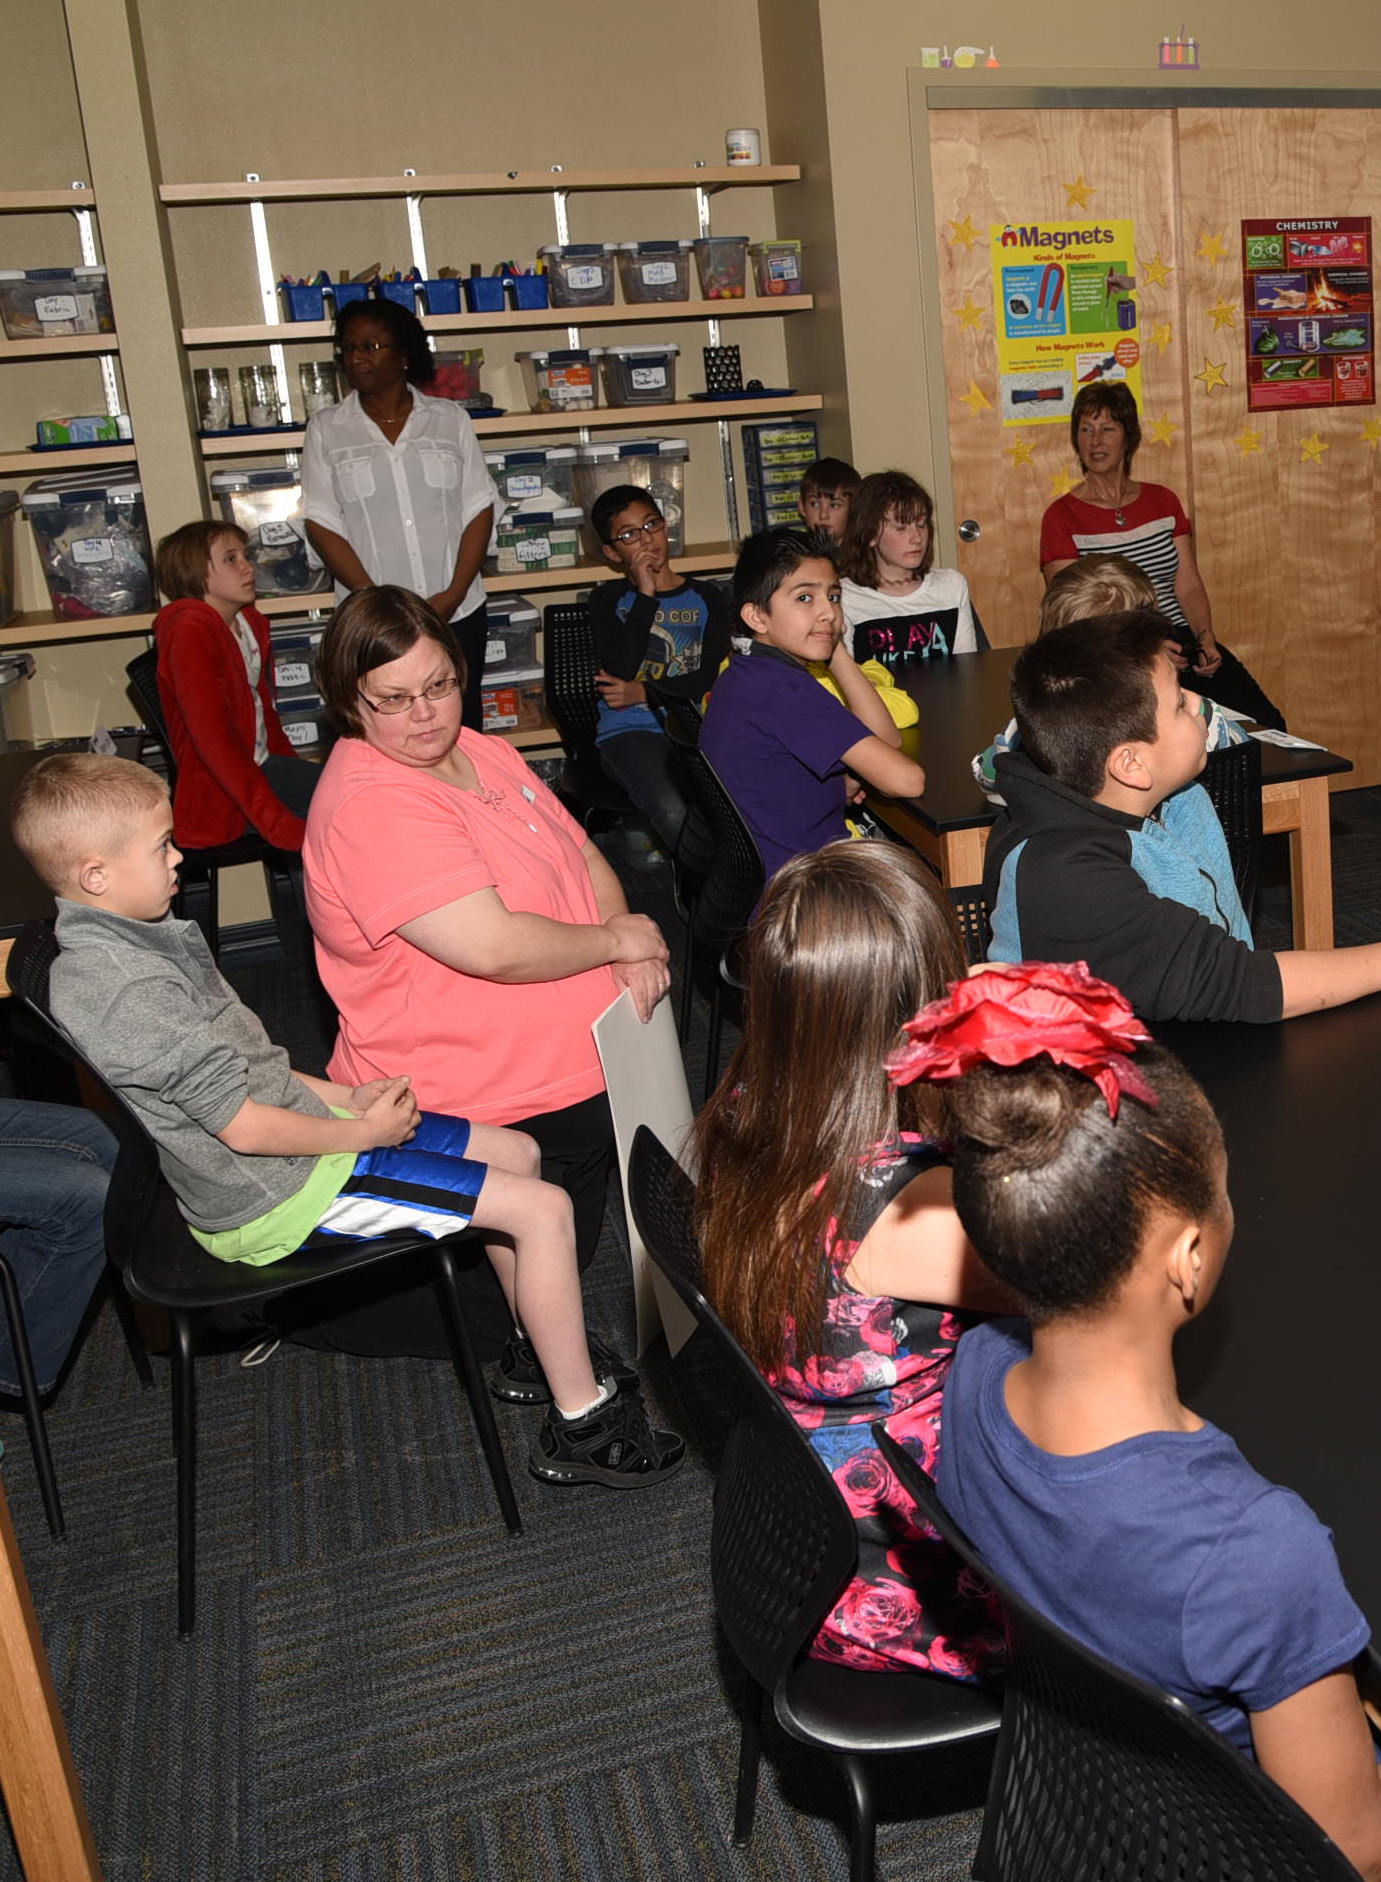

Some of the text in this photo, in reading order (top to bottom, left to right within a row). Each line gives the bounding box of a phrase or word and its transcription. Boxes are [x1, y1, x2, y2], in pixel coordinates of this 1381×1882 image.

[1276, 221, 1338, 231] CHEMISTRY
[1020, 226, 1114, 250] Magnets
[1034, 252, 1096, 262] Kinds of Magnets
[1036, 340, 1105, 352] How Magnets Work
